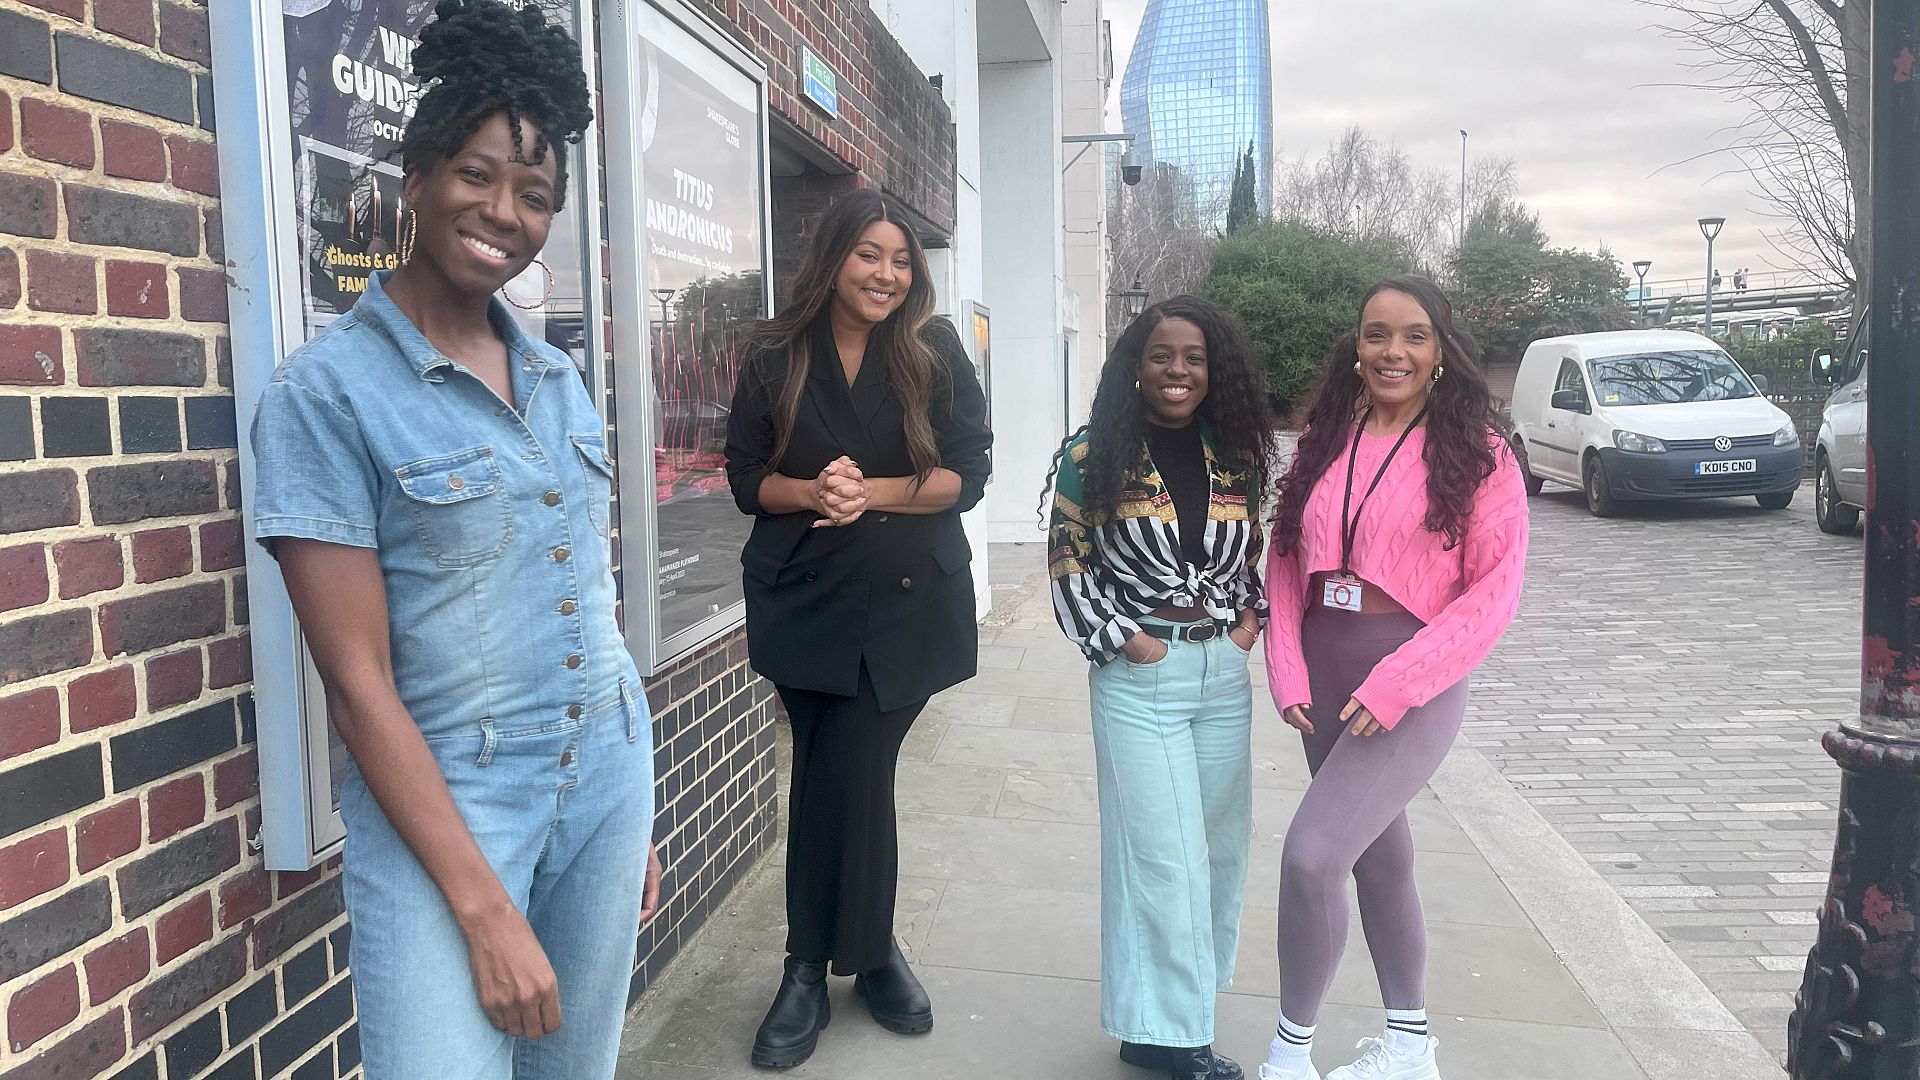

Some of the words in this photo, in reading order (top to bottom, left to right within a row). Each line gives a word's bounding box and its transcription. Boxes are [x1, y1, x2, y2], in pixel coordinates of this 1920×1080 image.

[673, 167, 714, 212] TITUS
[646, 198, 733, 254] ANDRONICUS
[326, 244, 371, 268] Ghosts
[374, 252, 384, 269] &
[1704, 463, 1729, 473] KD15
[1731, 461, 1752, 471] CNO
